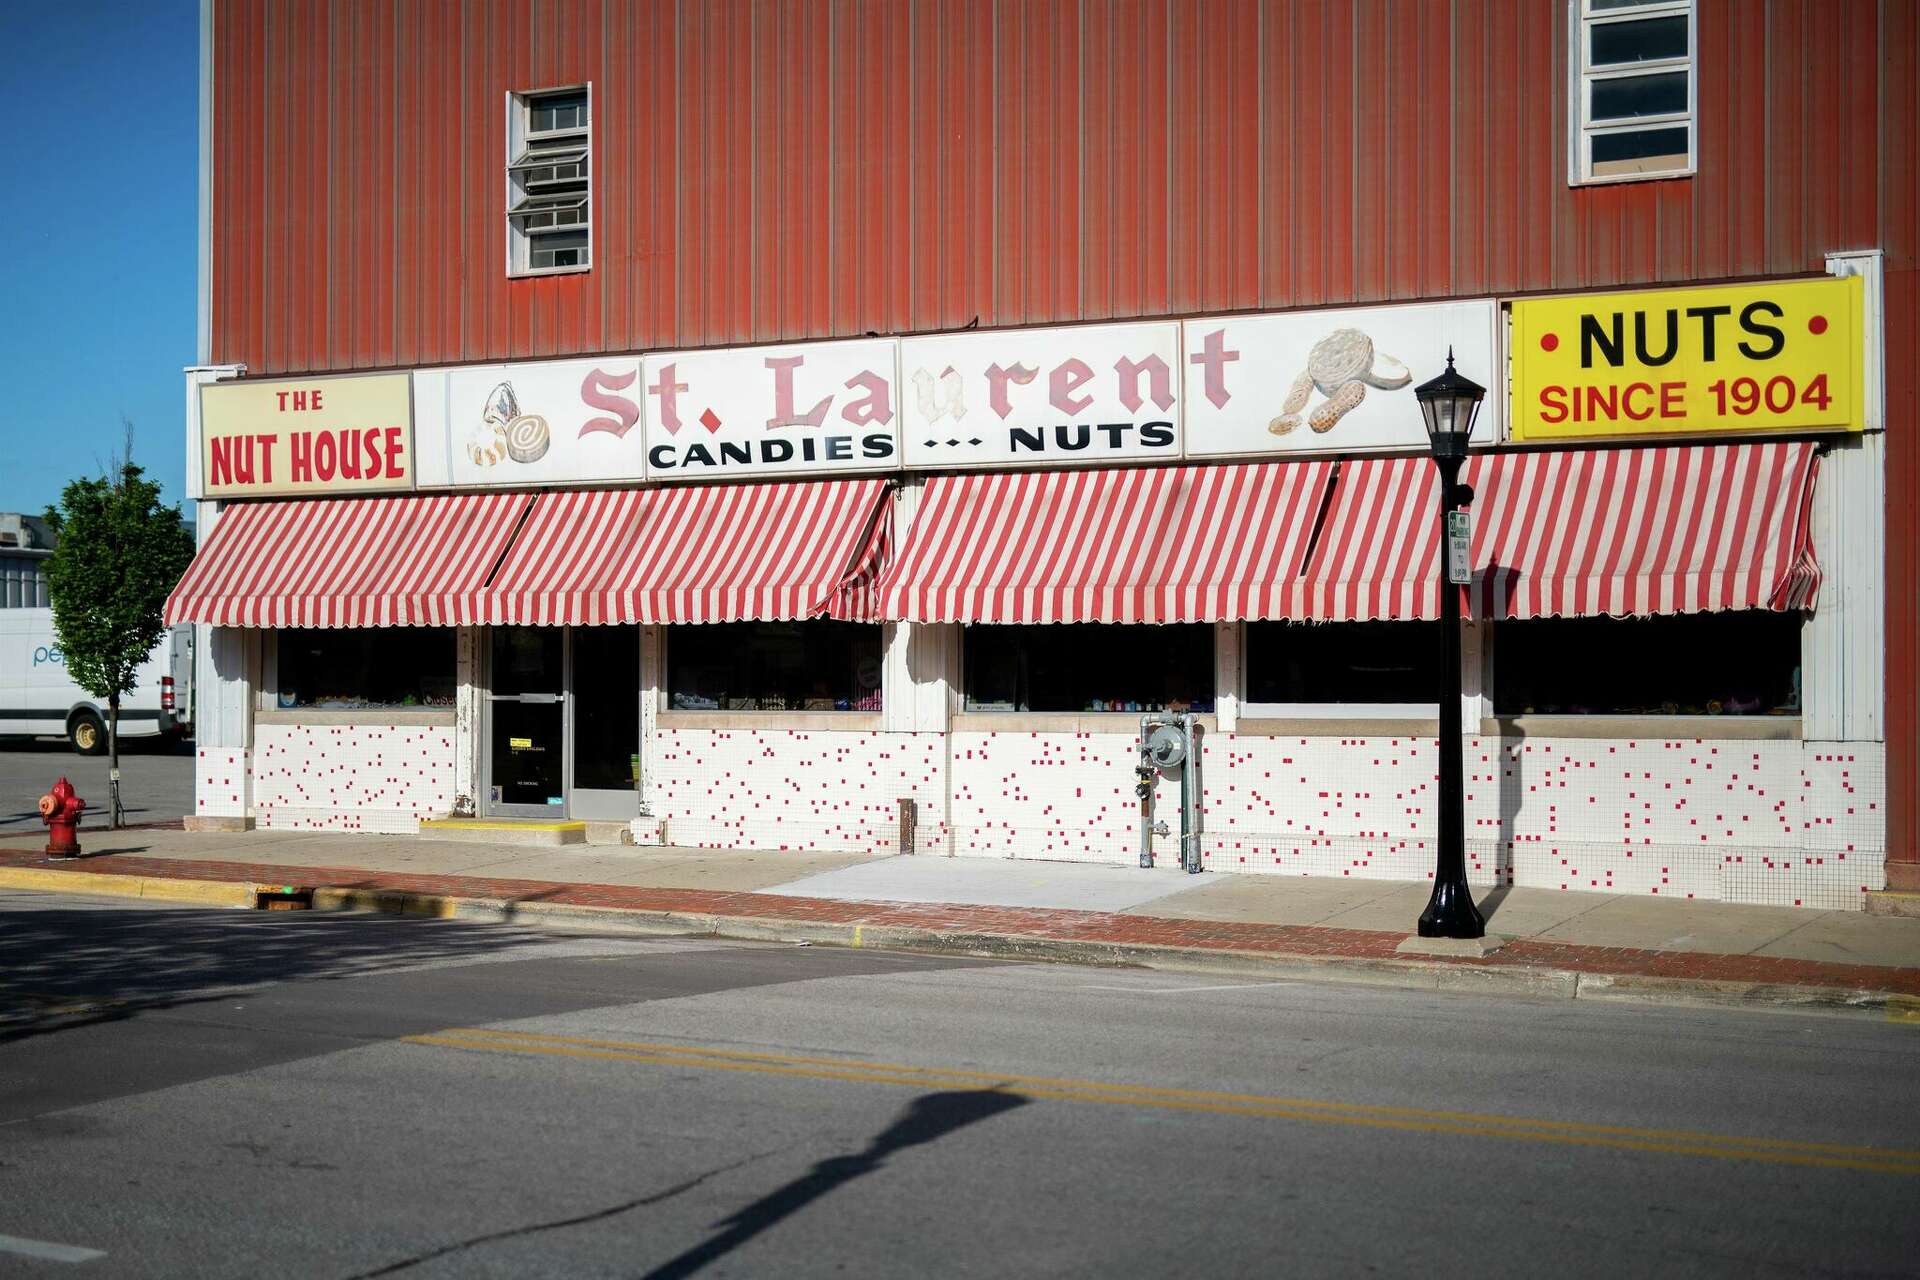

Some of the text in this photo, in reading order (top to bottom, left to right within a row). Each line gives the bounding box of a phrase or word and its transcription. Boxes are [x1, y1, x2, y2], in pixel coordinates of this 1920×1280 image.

[1580, 301, 1785, 368] NUTS
[276, 389, 324, 412] THE
[577, 328, 1240, 439] St. Laurent
[1539, 373, 1833, 424] SINCE 1904
[210, 426, 405, 486] NUT HOUSE
[649, 433, 895, 470] CANDIES
[1009, 421, 1175, 452] NUTS
